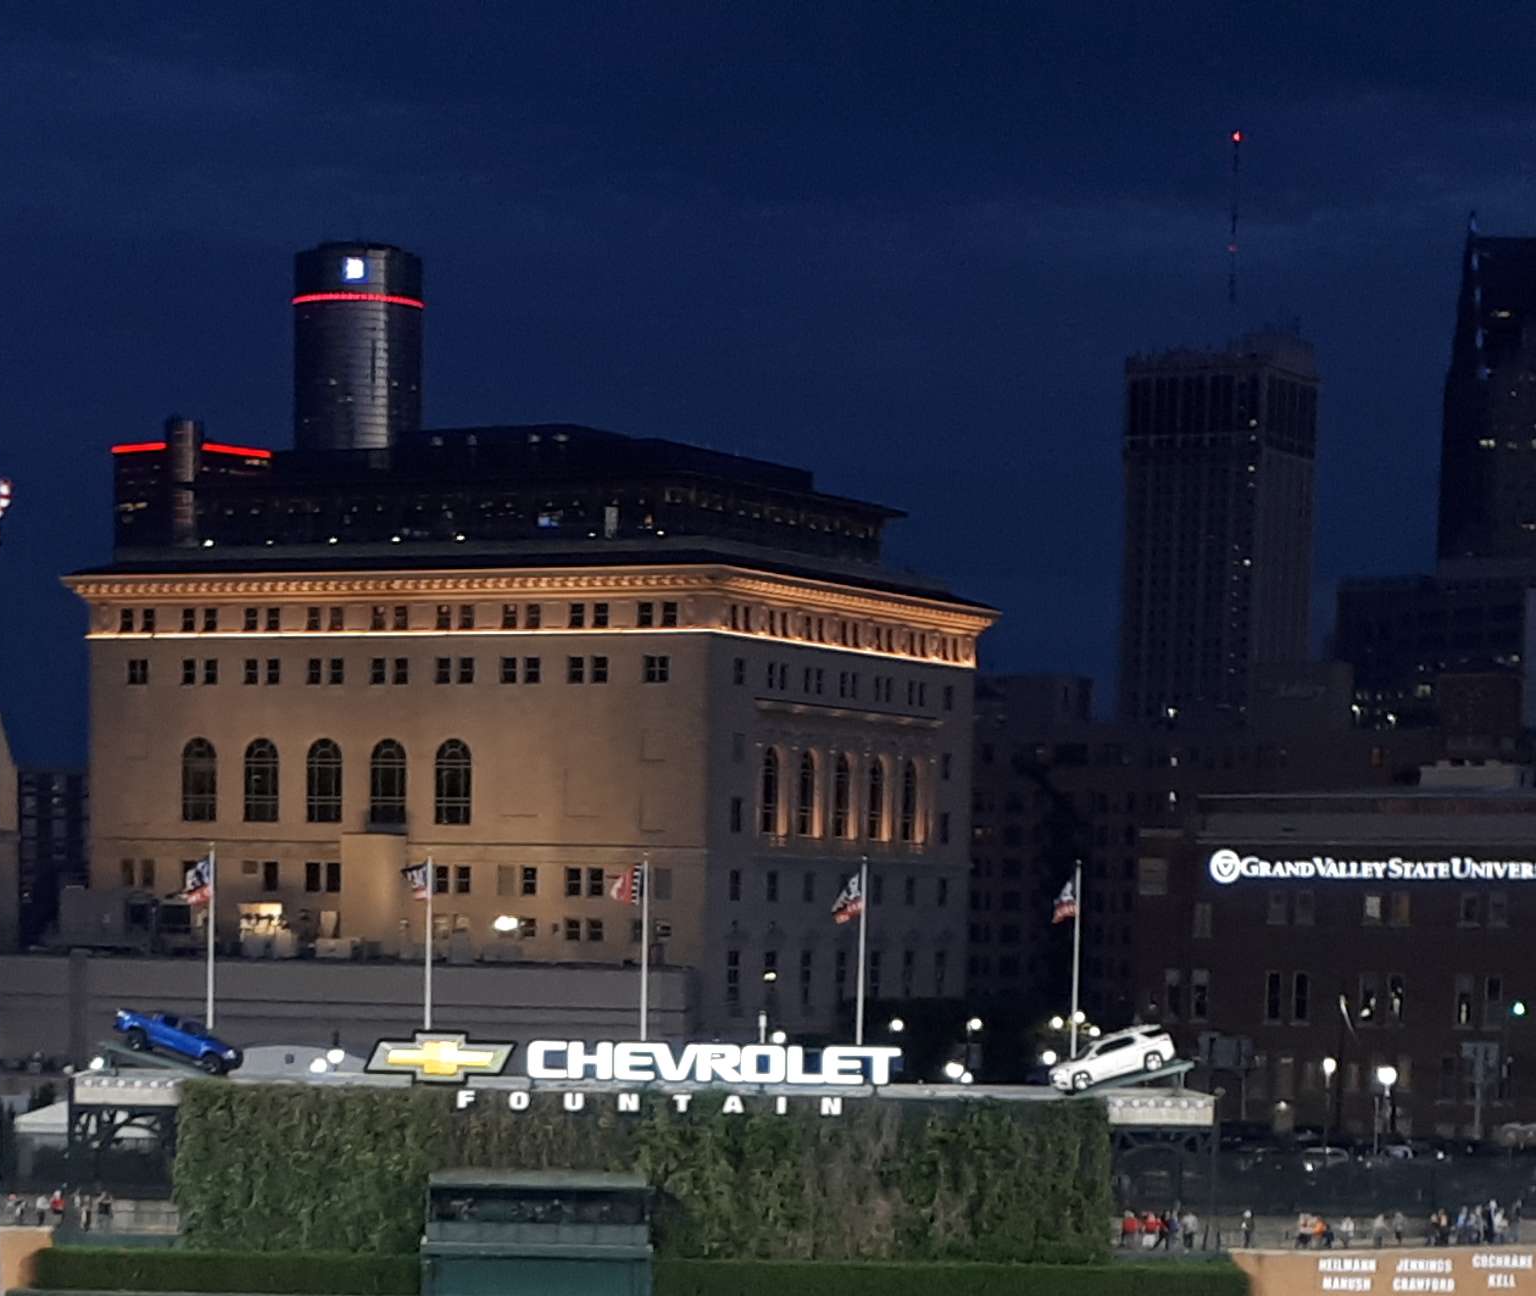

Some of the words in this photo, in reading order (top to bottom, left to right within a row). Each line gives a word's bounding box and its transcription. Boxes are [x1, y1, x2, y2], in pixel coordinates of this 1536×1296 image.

[1388, 857, 1450, 880] STATE
[526, 1040, 902, 1086] CHEVROLET
[456, 1089, 843, 1116] FOUNTAIN
